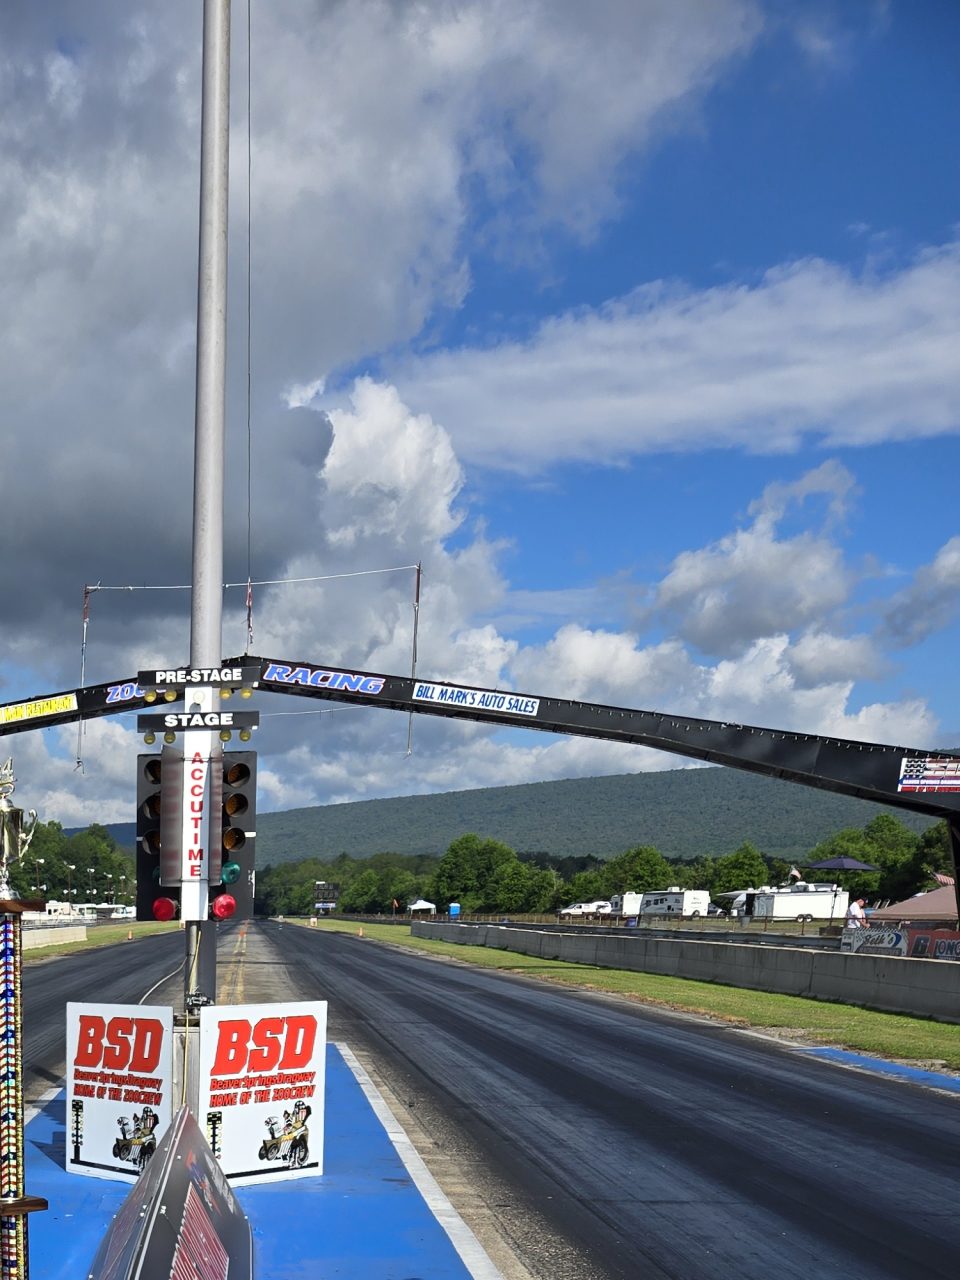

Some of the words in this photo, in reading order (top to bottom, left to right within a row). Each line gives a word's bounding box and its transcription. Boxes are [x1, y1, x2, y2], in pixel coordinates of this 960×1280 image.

[155, 668, 242, 683] PRE-STAGE
[263, 663, 385, 695] RACING
[415, 685, 435, 699] BILL
[439, 688, 477, 705] MARK'S
[477, 694, 505, 709] AUTO
[506, 698, 537, 713] SALES
[165, 713, 233, 727] STAGE
[188, 752, 204, 877] ACCUTIME
[74, 1015, 164, 1073] BSD
[210, 1015, 318, 1076] BSD
[73, 1083, 96, 1098] HOME
[96, 1086, 107, 1099] OF
[108, 1087, 123, 1102] THE
[209, 1092, 238, 1108] HOME
[239, 1091, 252, 1105] OF
[254, 1089, 271, 1103] THE
[272, 1085, 316, 1101] ZOOCREW
